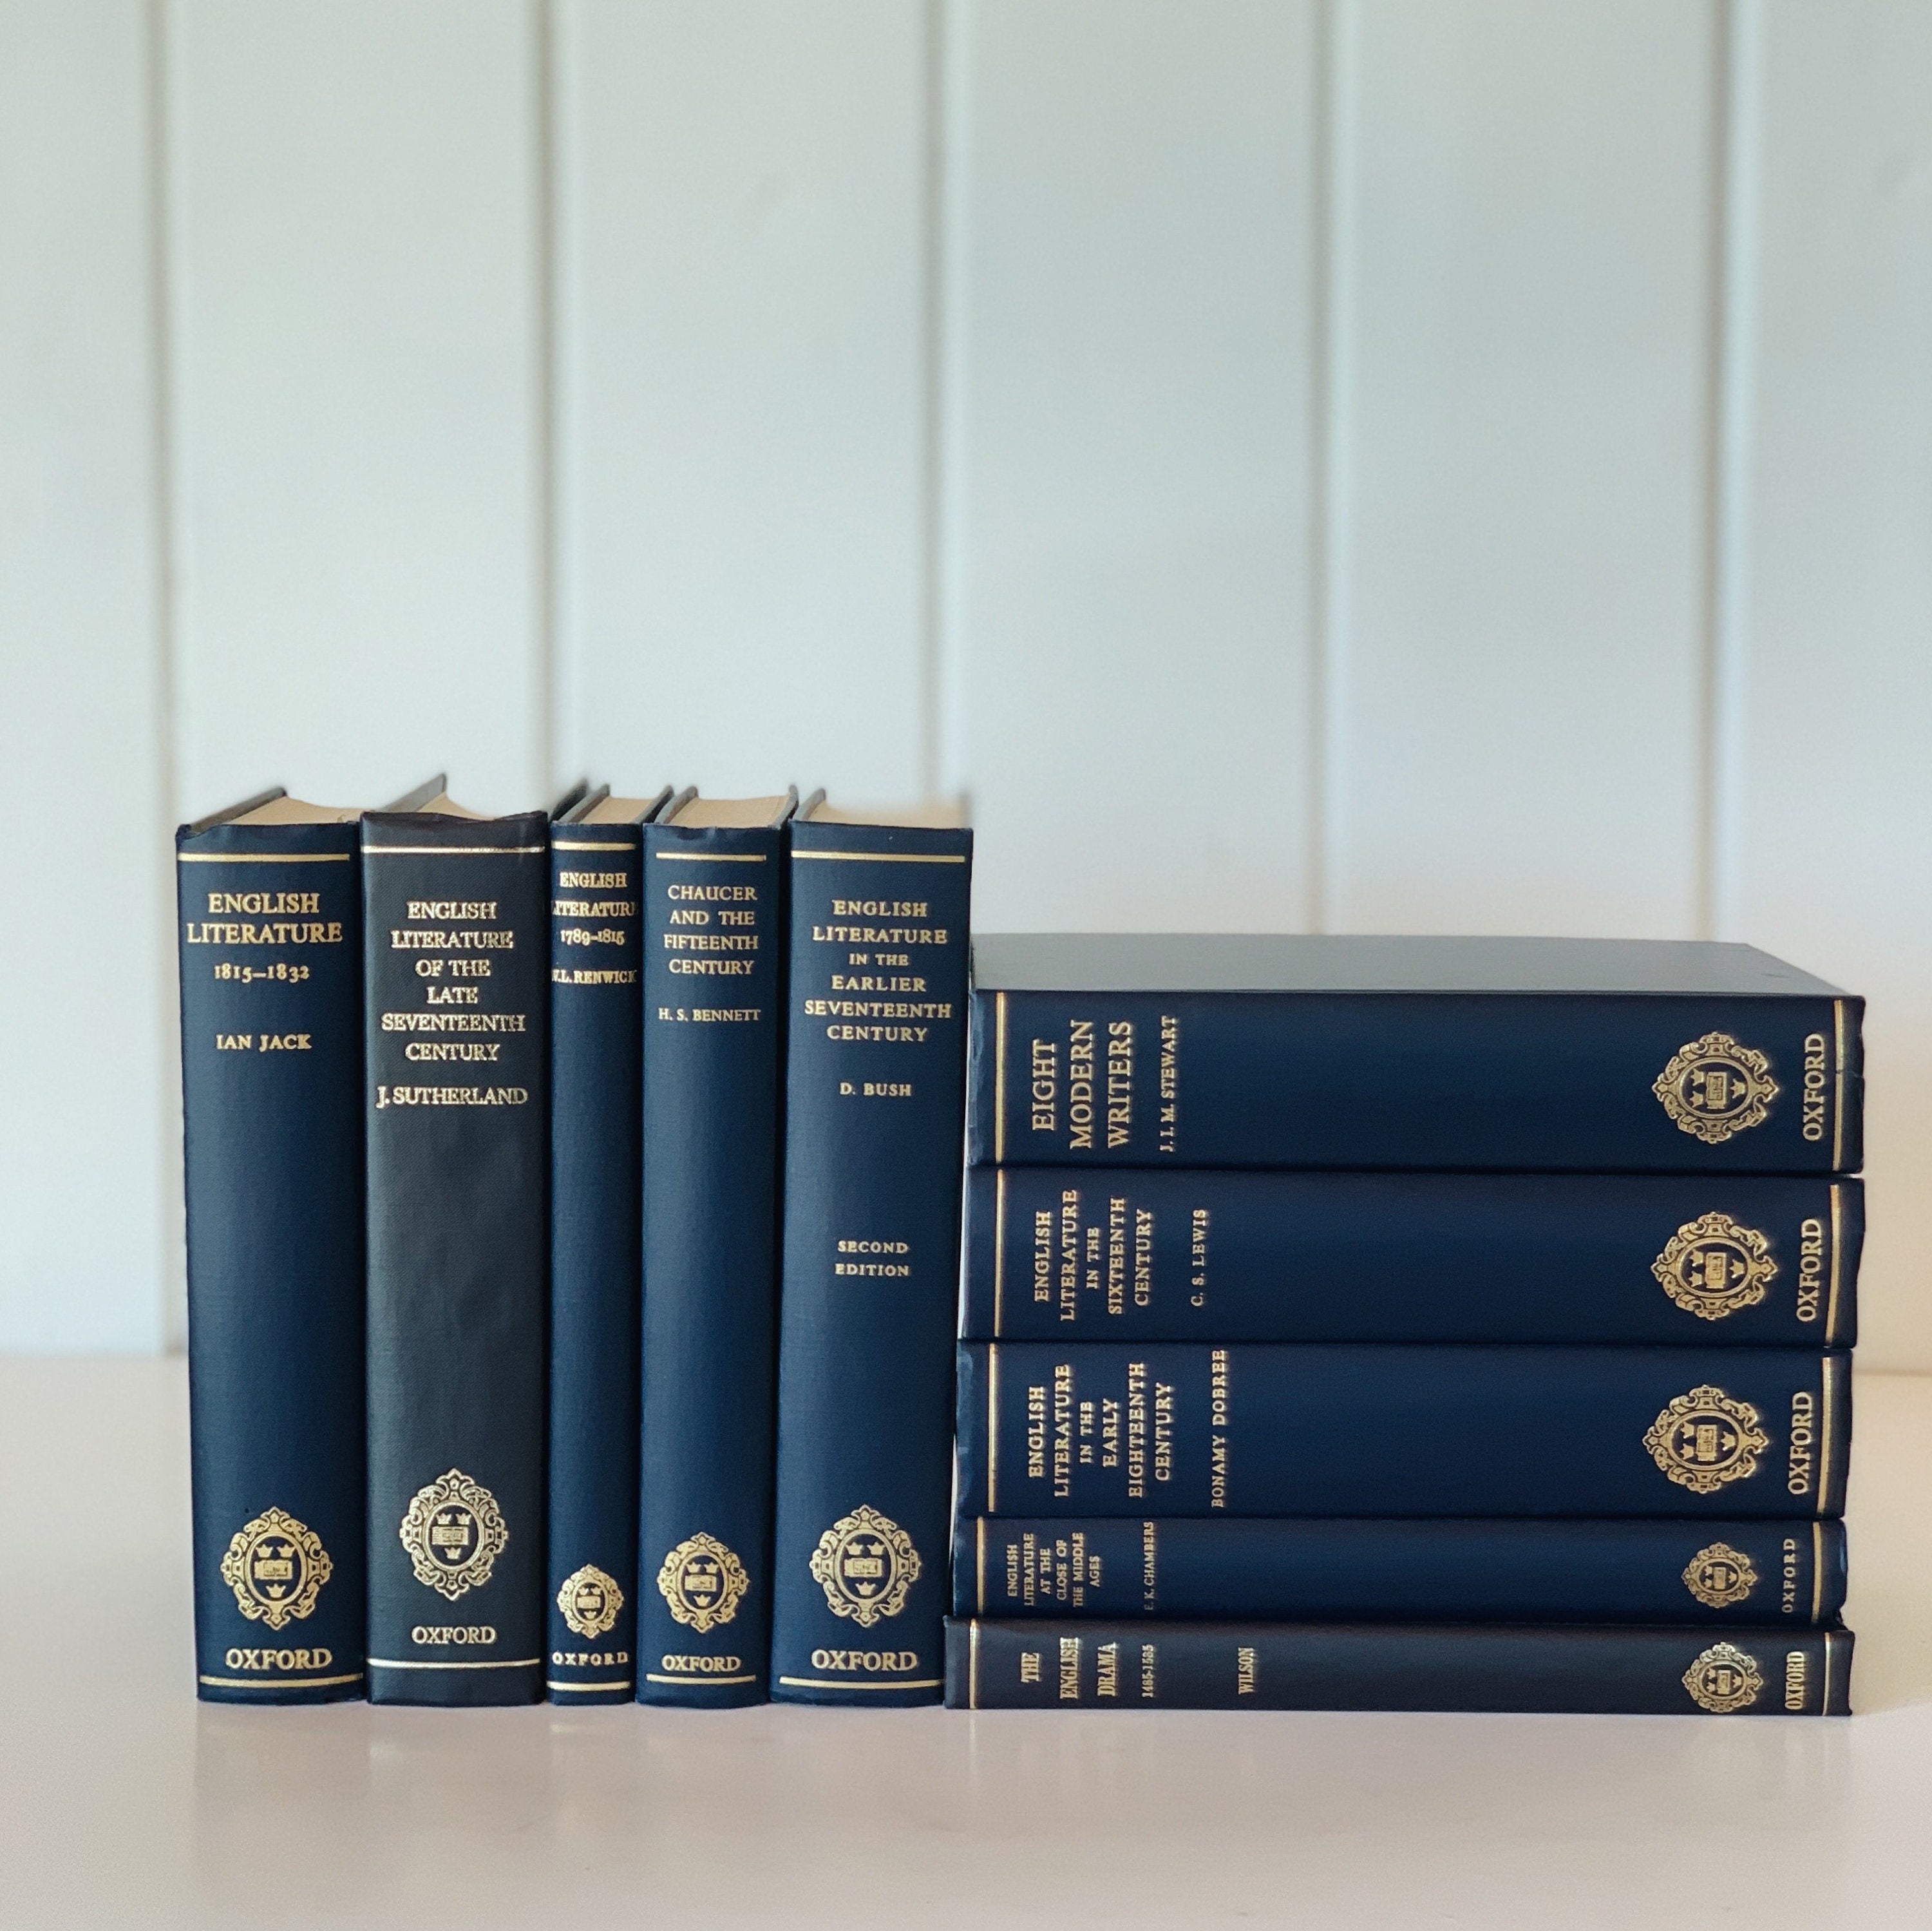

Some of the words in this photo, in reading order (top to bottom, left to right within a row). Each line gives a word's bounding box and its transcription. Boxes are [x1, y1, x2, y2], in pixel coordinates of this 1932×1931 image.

[559, 871, 627, 888] ENGLISH
[207, 892, 319, 914] ENGLISH
[667, 884, 757, 900] CHAUCER
[406, 901, 497, 920] ENGLISH
[669, 909, 709, 925] AND
[717, 911, 755, 926] THE
[831, 899, 927, 917] ENGLISH
[186, 922, 343, 944] LITERATURE
[390, 929, 514, 949] LITERATURE
[663, 933, 758, 950] FIFTEENTH
[812, 925, 947, 944] LITERATURE
[415, 959, 444, 977] OF
[448, 959, 491, 976] THE
[668, 958, 754, 975] CENTURY
[849, 953, 868, 966] IN
[875, 953, 909, 966] THE
[573, 969, 637, 984] RENWICK
[831, 975, 926, 992] EARLIER
[426, 986, 478, 1004] LATE
[658, 1007, 673, 1021] H.
[676, 1008, 688, 1022] S.
[692, 1009, 761, 1022] BENNETT
[804, 999, 951, 1018] SEVENTEENTH
[381, 1013, 526, 1032] SEVENTEENTH
[826, 1025, 927, 1042] CENTURY
[216, 1034, 252, 1050] IAN
[259, 1034, 312, 1052] JACK
[404, 1042, 500, 1061] CENTURY
[1160, 1015, 1177, 1099] STEWART
[840, 1082, 856, 1095] D.
[863, 1083, 911, 1096] BUSH
[1032, 1038, 1057, 1131] EIGHT
[1070, 1019, 1094, 1149] MODERN
[1108, 1021, 1133, 1148] WRITERS
[1803, 1033, 1826, 1141] OXFORD
[375, 1085, 390, 1109] J.
[392, 1086, 527, 1105] SUTHERLAND
[1160, 1103, 1175, 1123] M.
[1160, 1127, 1175, 1137] I.
[1159, 1141, 1174, 1152] J.
[837, 1240, 909, 1253] SECOND
[1086, 1227, 1100, 1262] THE
[1192, 1209, 1209, 1266] LEWIS
[1034, 1211, 1052, 1302] ENGLISH
[1060, 1190, 1079, 1321] LITERATURE
[1108, 1197, 1126, 1315] SIXTEENTH
[1134, 1208, 1153, 1306] CENTURY
[835, 1263, 909, 1277] EDITION
[1086, 1269, 1099, 1289] IN
[1191, 1273, 1205, 1286] S.
[1796, 1219, 1824, 1322] OXFORD
[1190, 1292, 1204, 1307] C.
[1211, 1349, 1227, 1426] DOBREE
[1080, 1402, 1094, 1436] THE
[1028, 1386, 1046, 1478] ENGLISH
[1054, 1364, 1072, 1497] LITERATURE
[1103, 1398, 1120, 1467] EARLY
[1128, 1363, 1146, 1498] EIGHTEENTH
[1155, 1382, 1173, 1481] CENTURY
[1079, 1444, 1092, 1463] IN
[1788, 1391, 1814, 1495] OXFORD
[1211, 1434, 1226, 1508] BONAMY
[1056, 1539, 1067, 1557] OF
[1072, 1532, 1084, 1581] MIDDLE
[1143, 1521, 1155, 1586] CHAMBERS
[1006, 1544, 1019, 1597] ENGLISH
[1023, 1533, 1036, 1606] LITERATURE
[1039, 1548, 1052, 1574] THE
[1088, 1555, 1101, 1587] AGES
[1040, 1578, 1051, 1594] AT
[1056, 1563, 1068, 1601] CLOSE
[1783, 1538, 1797, 1613] OXFORD
[1072, 1586, 1084, 1607] THE
[1144, 1588, 1155, 1599] K.
[412, 1626, 496, 1644] OXFORD
[225, 1648, 332, 1670] OXFORD
[551, 1651, 628, 1666] OXFORD
[661, 1654, 741, 1673] OXFORD
[811, 1649, 918, 1671] OXFORD
[1021, 1652, 1040, 1683] THE
[1059, 1637, 1081, 1699] ENGLISH
[1097, 1642, 1119, 1697] DRAMA
[1238, 1647, 1256, 1695] WILSON
[1785, 1651, 1806, 1710] OXFORD
